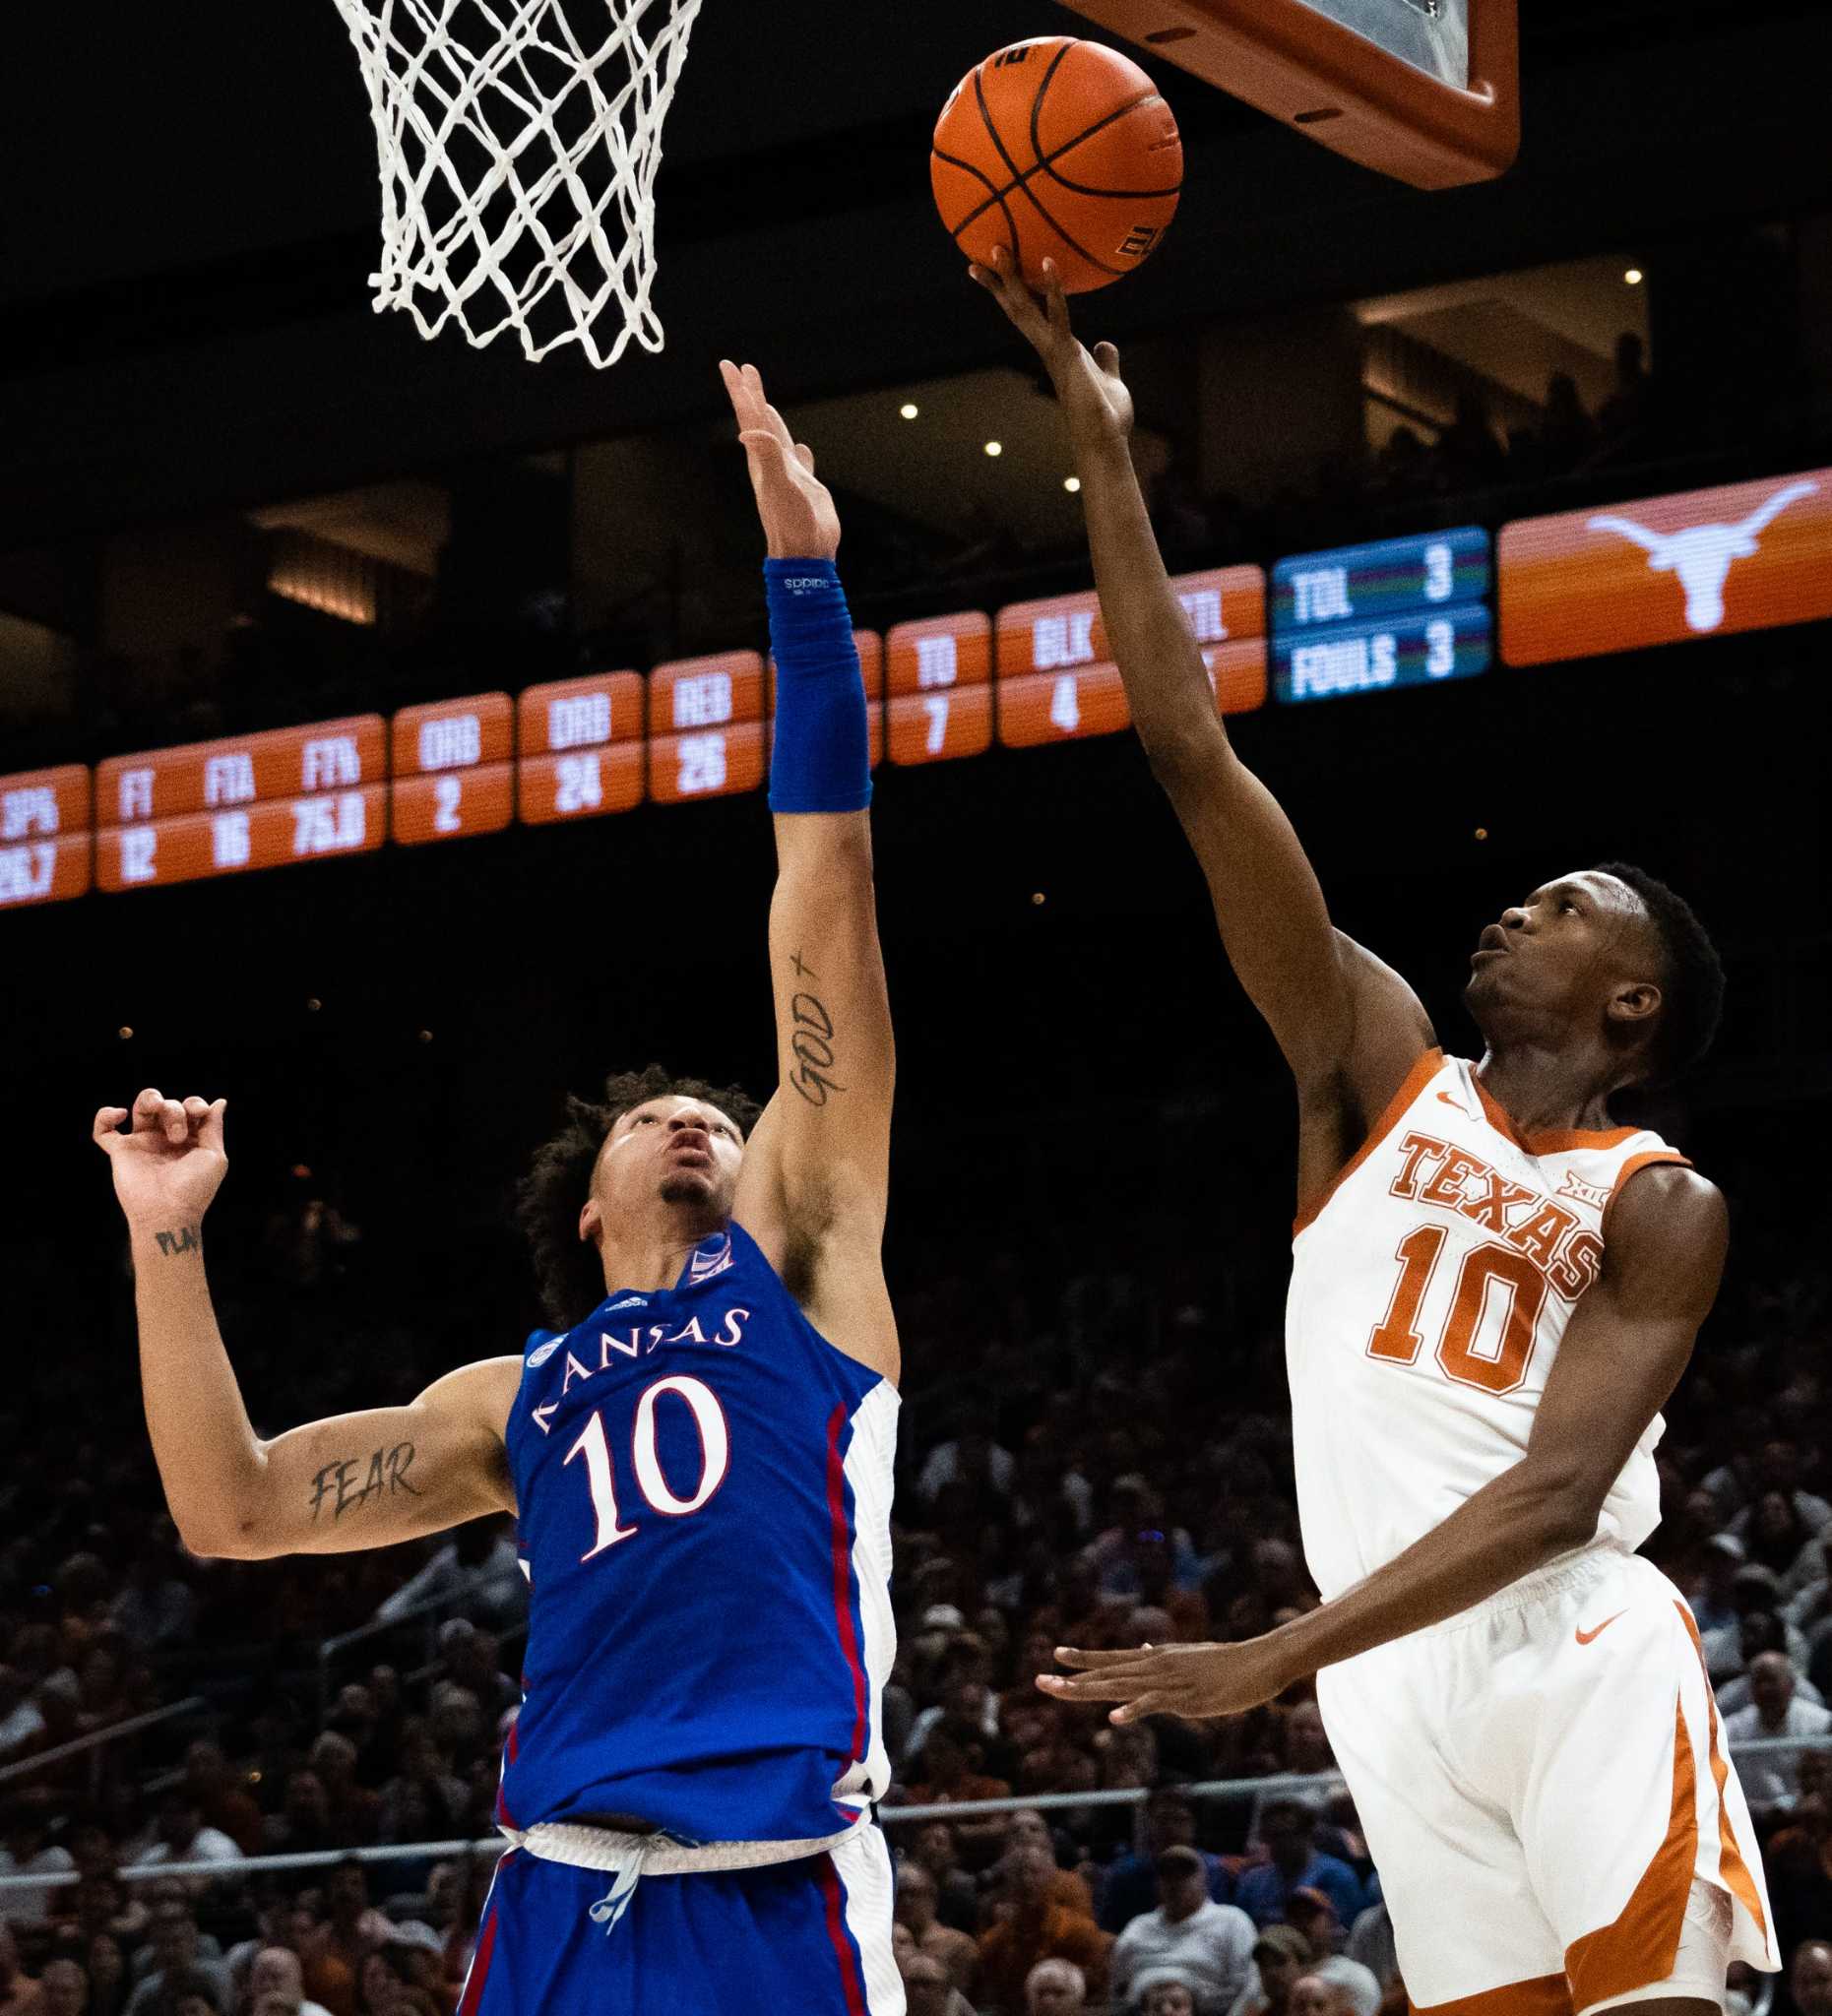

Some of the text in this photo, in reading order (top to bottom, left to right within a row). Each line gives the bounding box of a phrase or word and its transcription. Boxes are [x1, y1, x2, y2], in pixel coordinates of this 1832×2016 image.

[1291, 632, 1398, 700] FOULS
[922, 695, 949, 755] 7
[433, 774, 461, 833] 2
[789, 992, 848, 1106] GOD
[1389, 1130, 1606, 1302] TEXAS
[1365, 1224, 1549, 1397] 10
[309, 1441, 425, 1522] FEAR
[562, 1374, 730, 1562] 10
